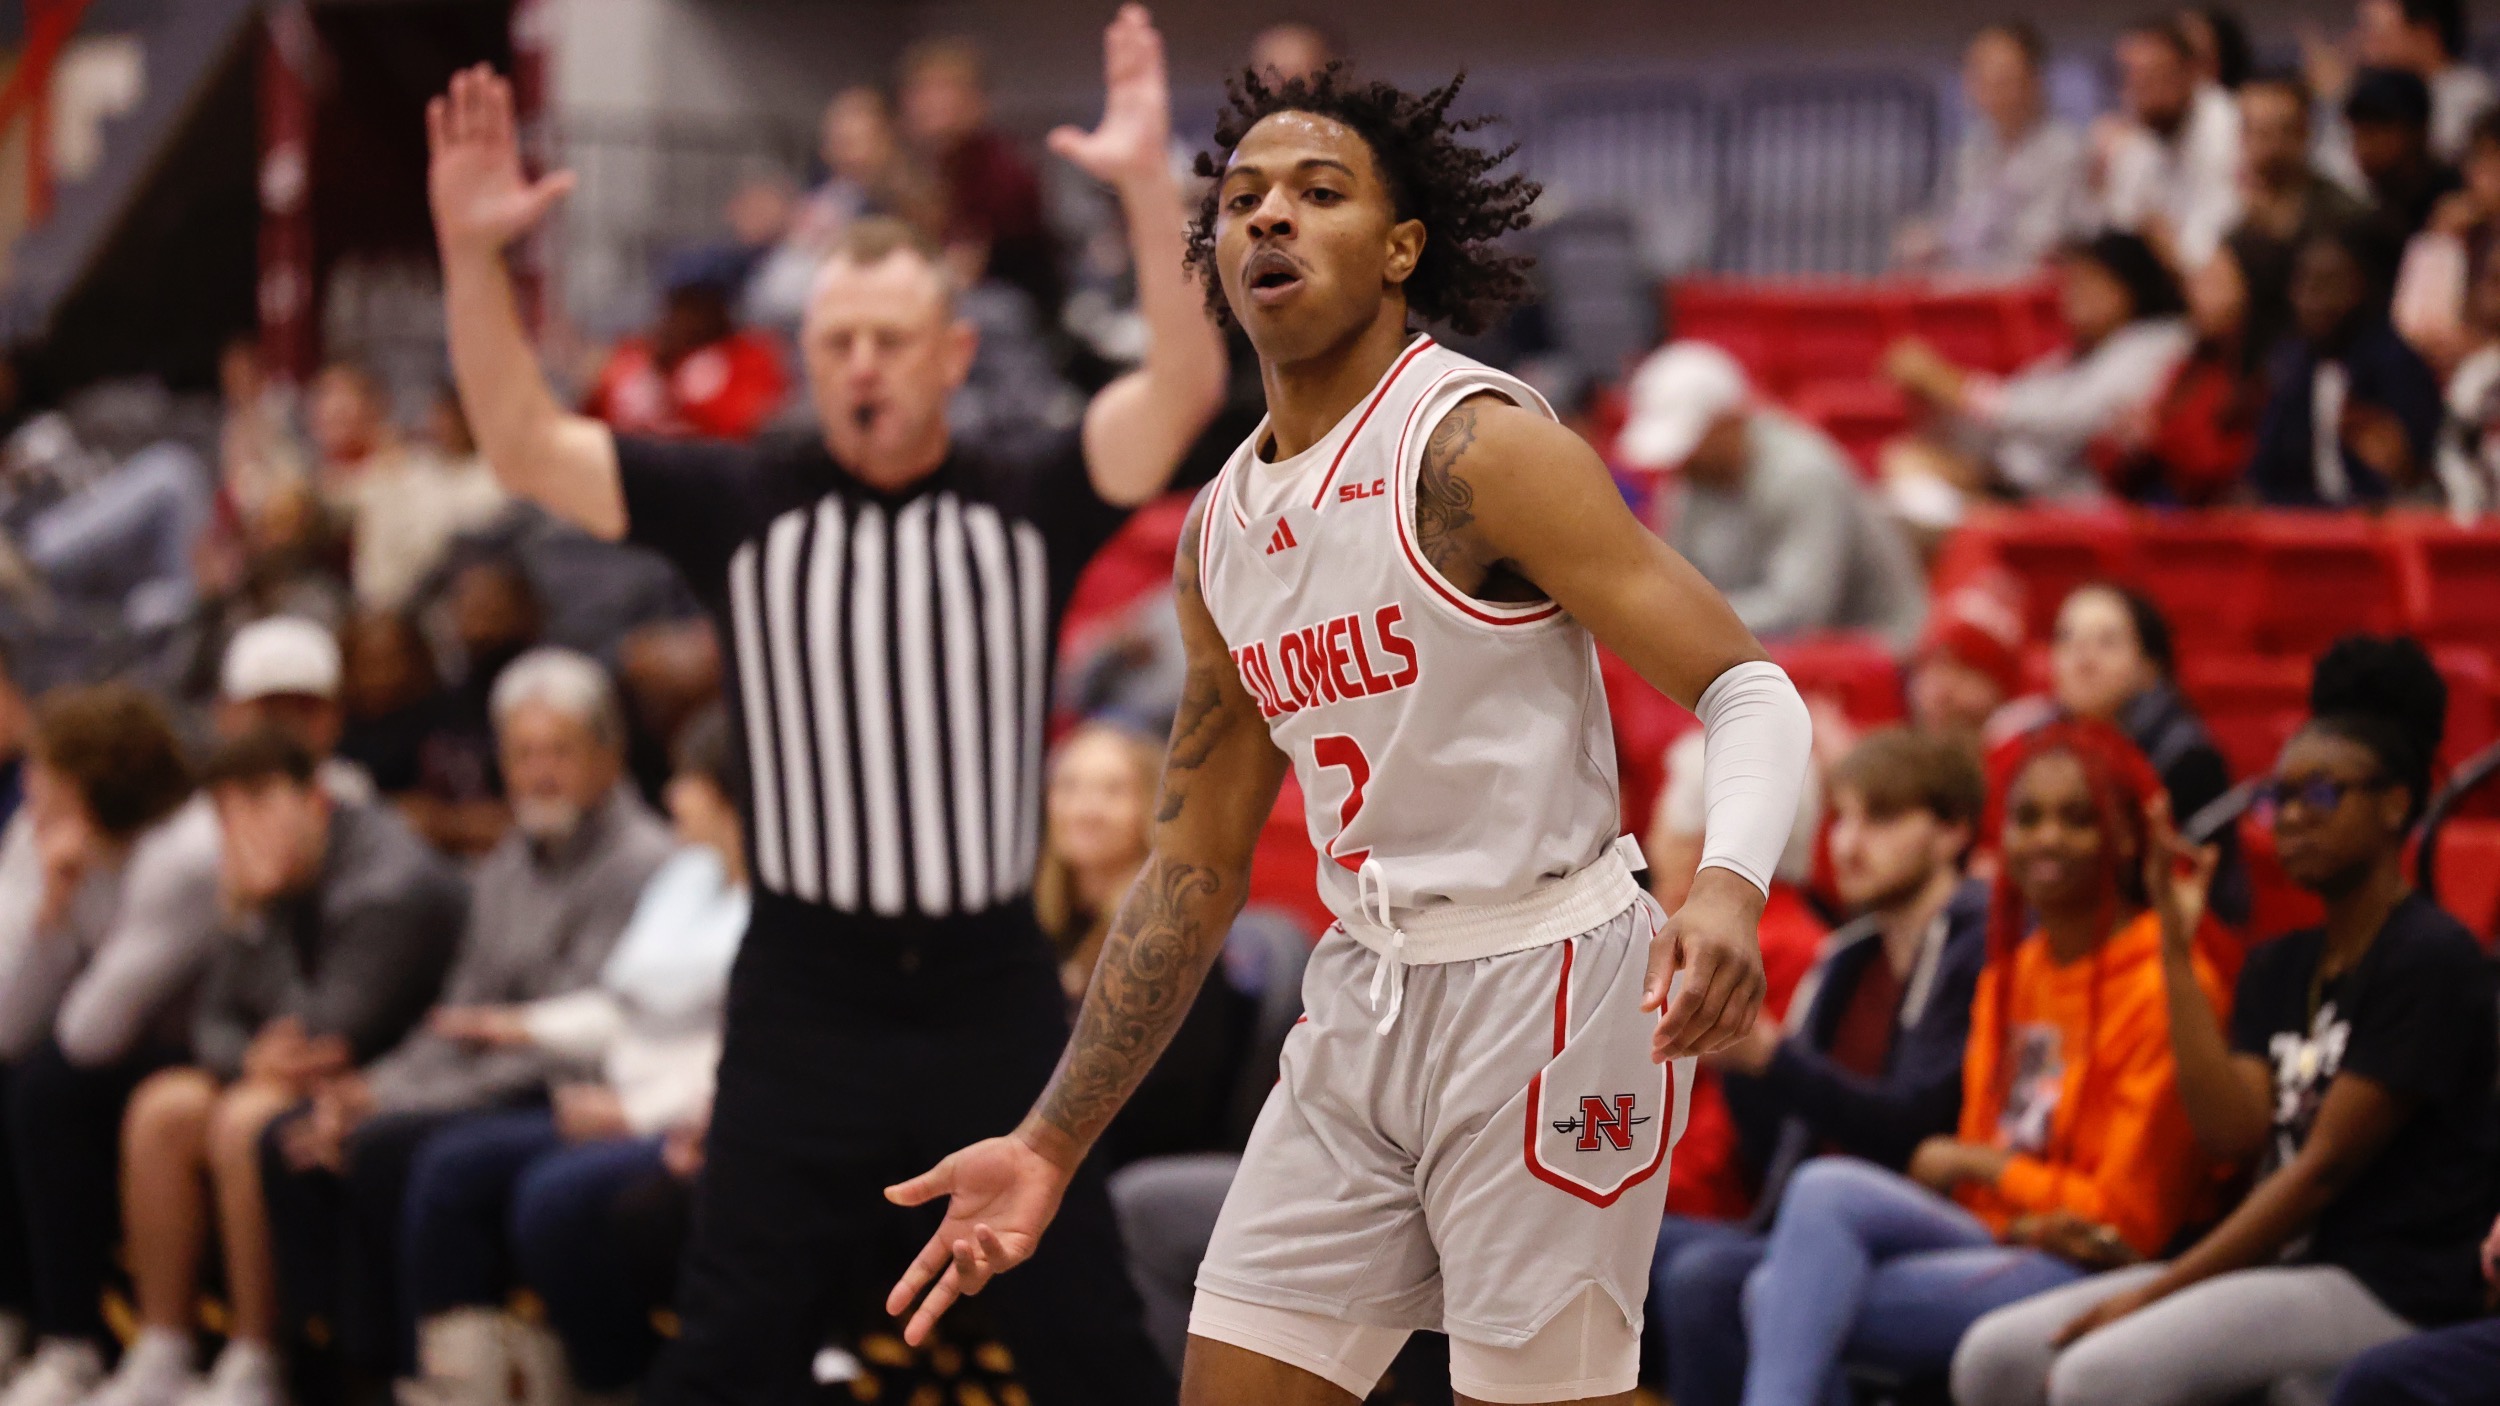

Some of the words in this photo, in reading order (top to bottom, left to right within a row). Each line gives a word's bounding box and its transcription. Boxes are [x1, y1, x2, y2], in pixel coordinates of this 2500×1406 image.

[1338, 477, 1385, 503] SLC
[1311, 731, 1373, 874] 2
[1576, 1093, 1635, 1152] N
